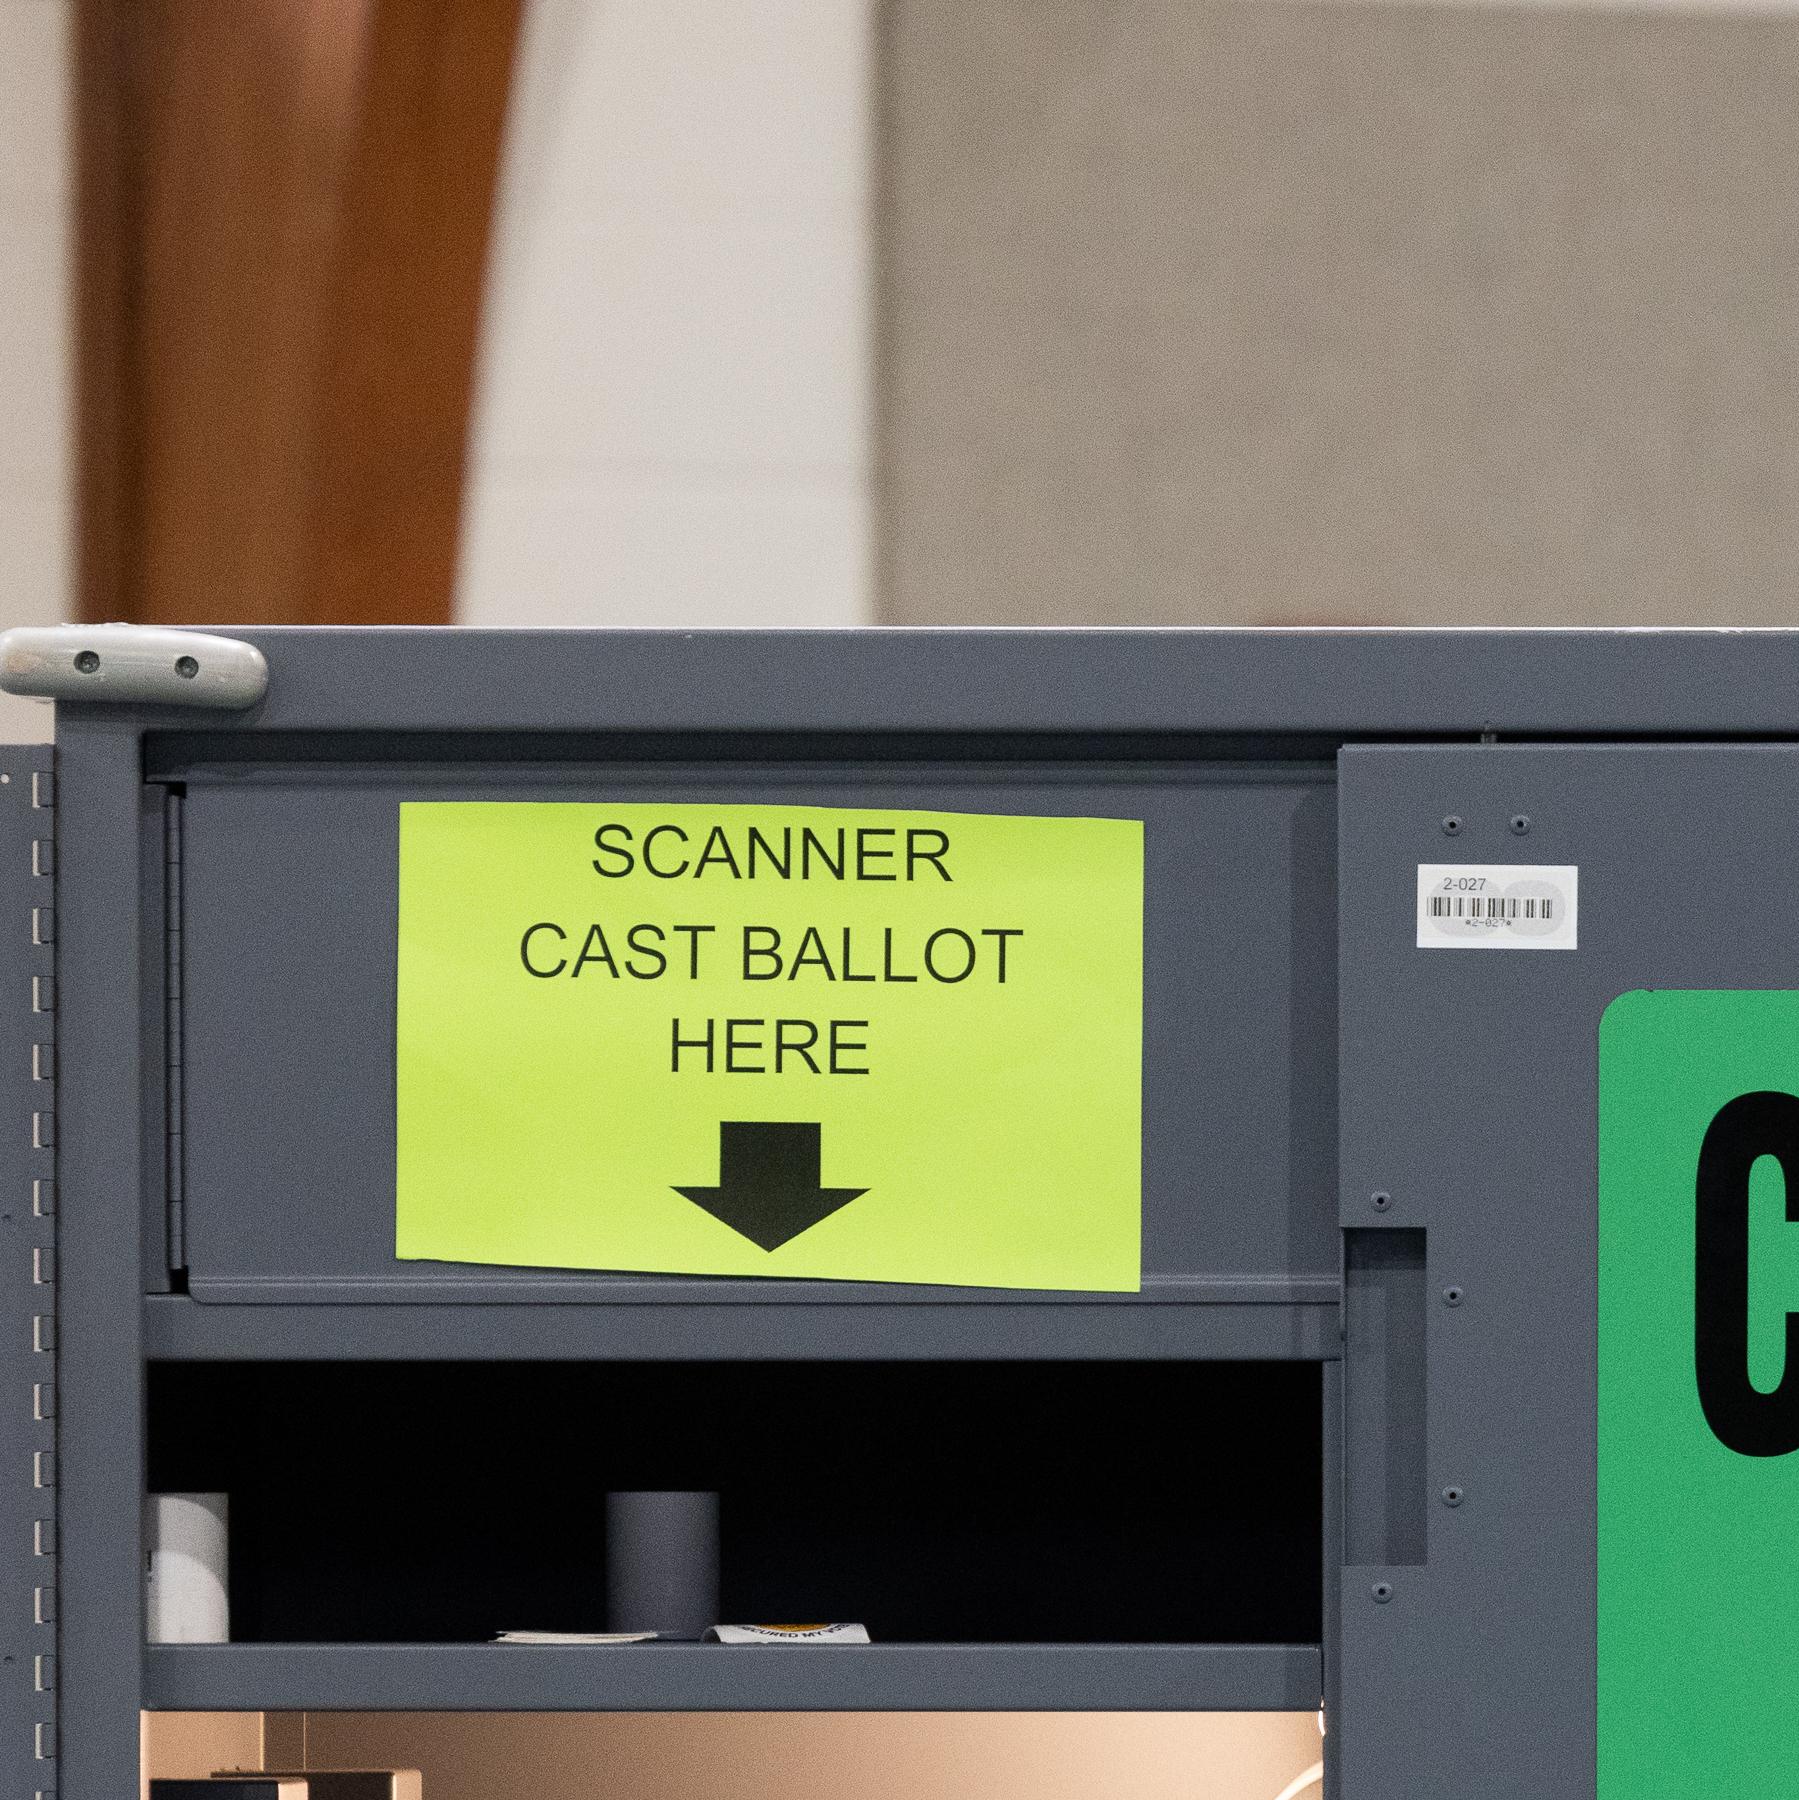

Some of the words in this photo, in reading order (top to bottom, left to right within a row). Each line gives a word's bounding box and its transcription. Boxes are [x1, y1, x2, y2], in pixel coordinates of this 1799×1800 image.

[592, 823, 953, 882] SCANNER
[1443, 878, 1487, 891] 2-027
[520, 922, 716, 980] CAST
[743, 926, 1024, 984] BALLOT
[671, 1018, 870, 1075] HERE
